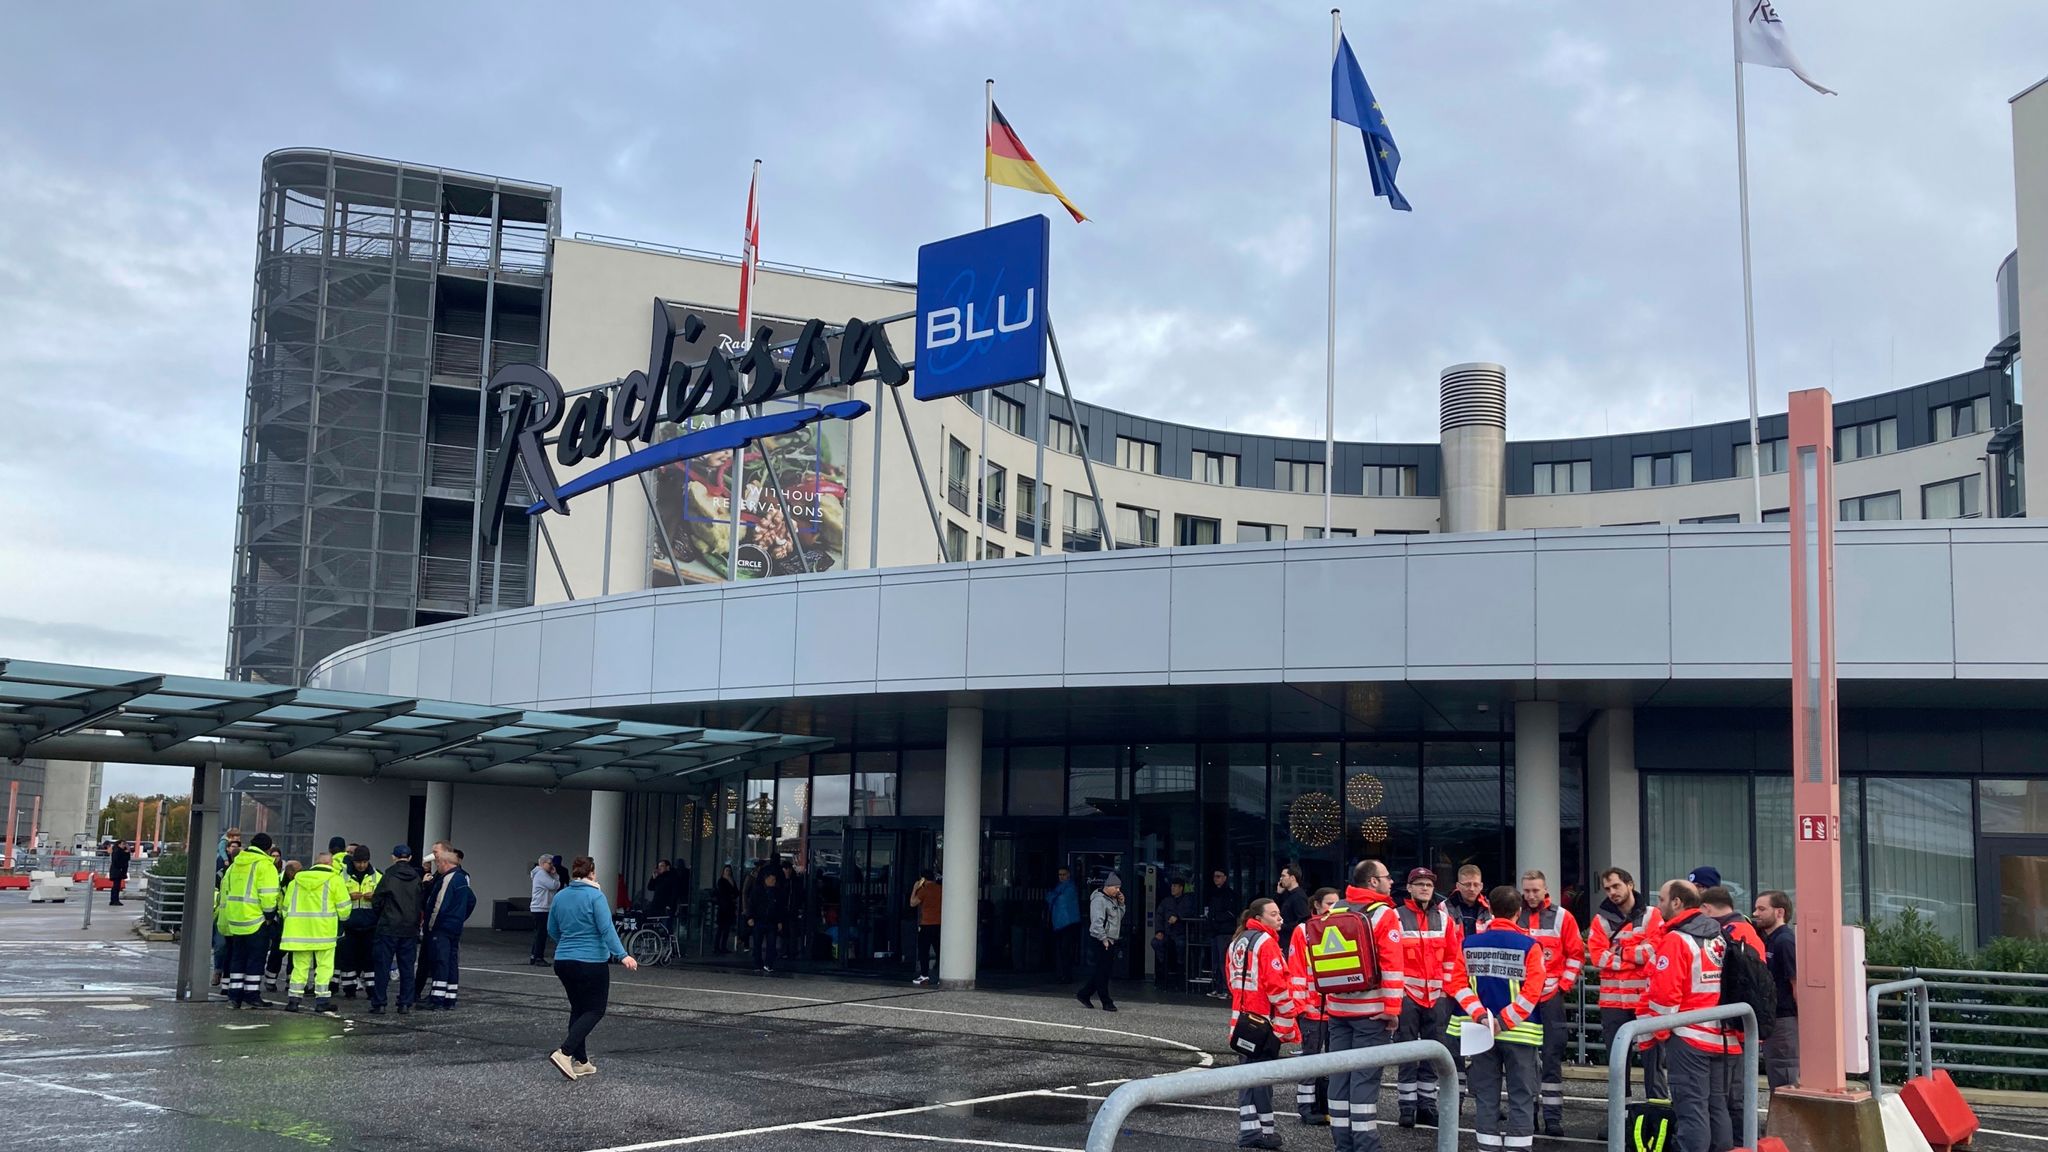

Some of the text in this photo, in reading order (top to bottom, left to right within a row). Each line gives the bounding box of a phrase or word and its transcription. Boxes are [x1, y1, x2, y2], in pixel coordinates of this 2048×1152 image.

[485, 288, 1034, 546] Radisson BLU
[750, 487, 824, 503] WITHOUT
[712, 497, 823, 517] REERVATIONS
[737, 559, 762, 568] CIRCLE
[1465, 950, 1521, 962] Gruppenführer
